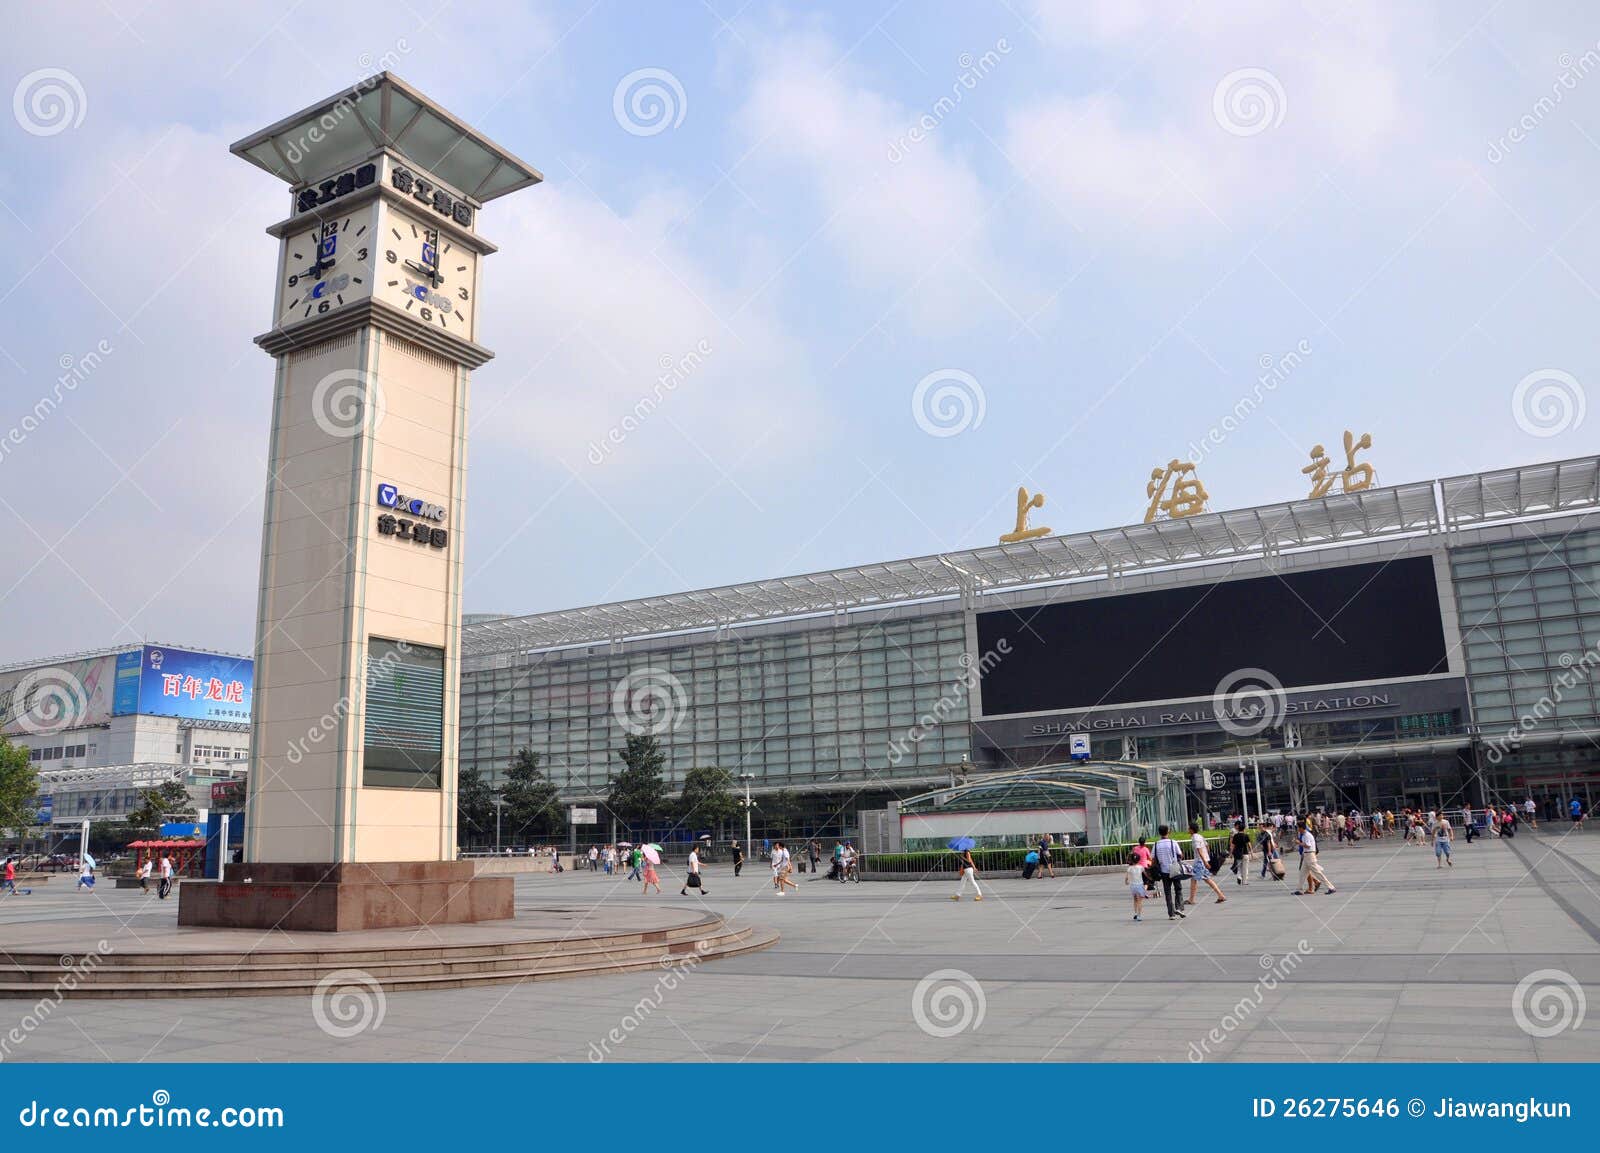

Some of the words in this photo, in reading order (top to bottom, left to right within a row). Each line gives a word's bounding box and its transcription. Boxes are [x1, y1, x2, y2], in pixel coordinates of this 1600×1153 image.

[357, 247, 368, 261] 3
[386, 250, 397, 264] 9
[288, 275, 298, 287] 9
[458, 287, 468, 300] 3
[318, 300, 330, 313] 6
[420, 307, 433, 321] 6
[999, 430, 1372, 542] 上海站
[394, 495, 447, 522] XCMG
[161, 673, 244, 704] 百年龙虎
[1032, 716, 1146, 734] SHANGHAI
[1160, 704, 1267, 724] RAILWAY
[1284, 694, 1389, 713] STATION
